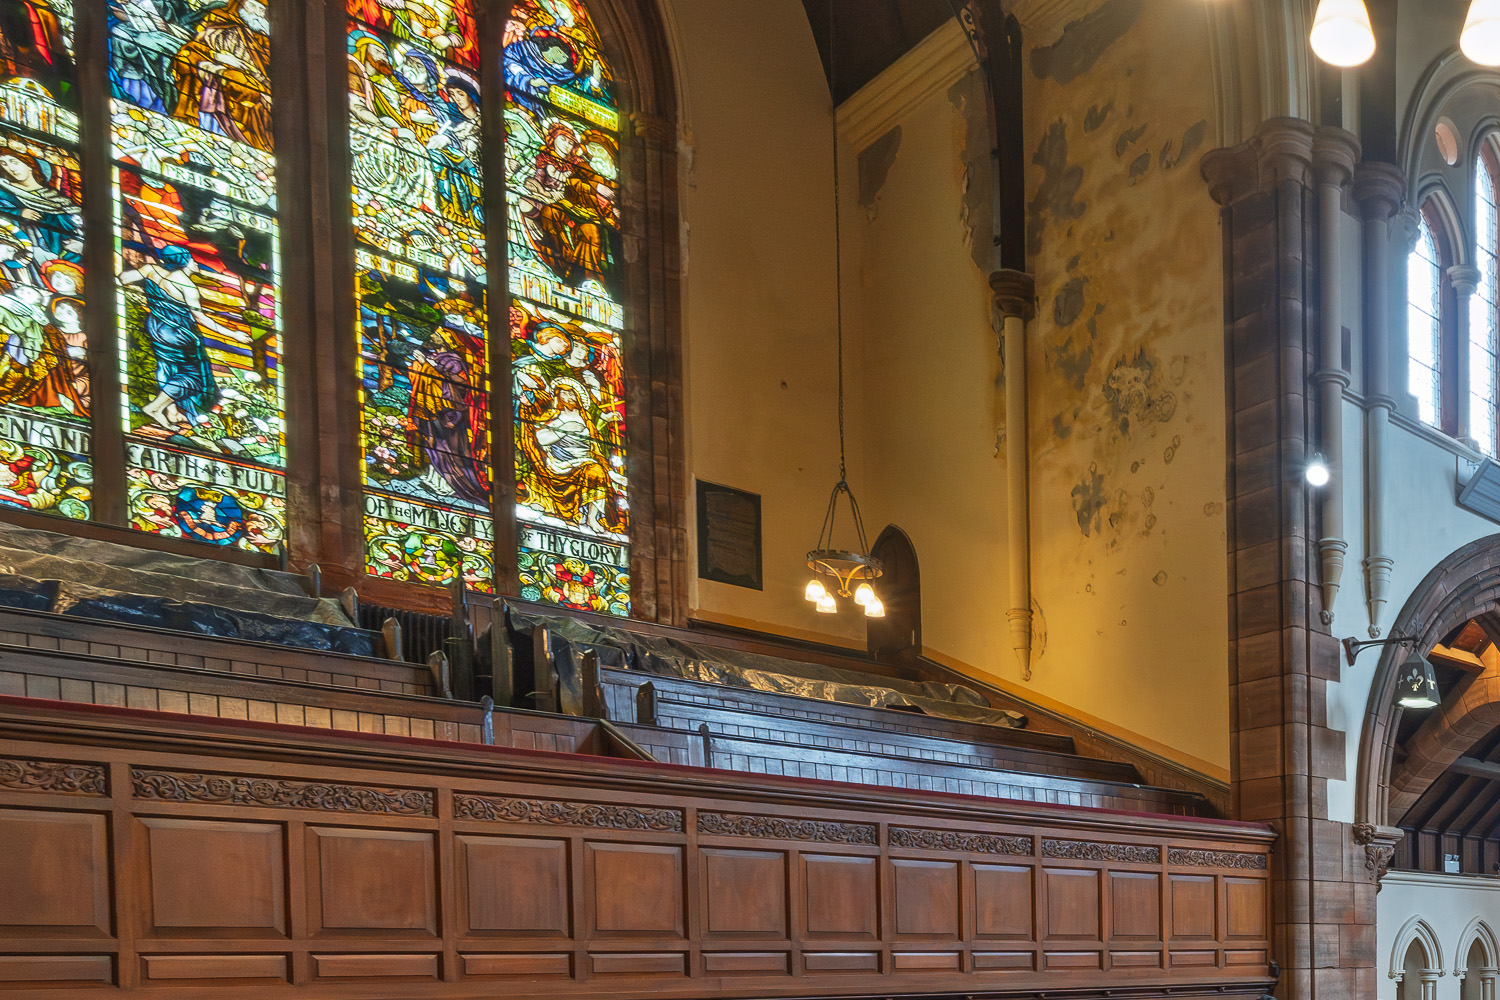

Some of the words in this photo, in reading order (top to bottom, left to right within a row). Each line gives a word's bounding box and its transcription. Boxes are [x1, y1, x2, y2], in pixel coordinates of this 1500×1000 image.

[236, 211, 269, 230] GOD
[409, 248, 424, 262] BE
[426, 254, 447, 269] THE
[126, 444, 200, 478] EARTH
[233, 466, 286, 495] FULL
[365, 498, 388, 517] OF
[388, 504, 411, 519] THE
[411, 507, 493, 540] MAJESTY
[537, 531, 567, 551] THY
[568, 538, 621, 566] GLORY
